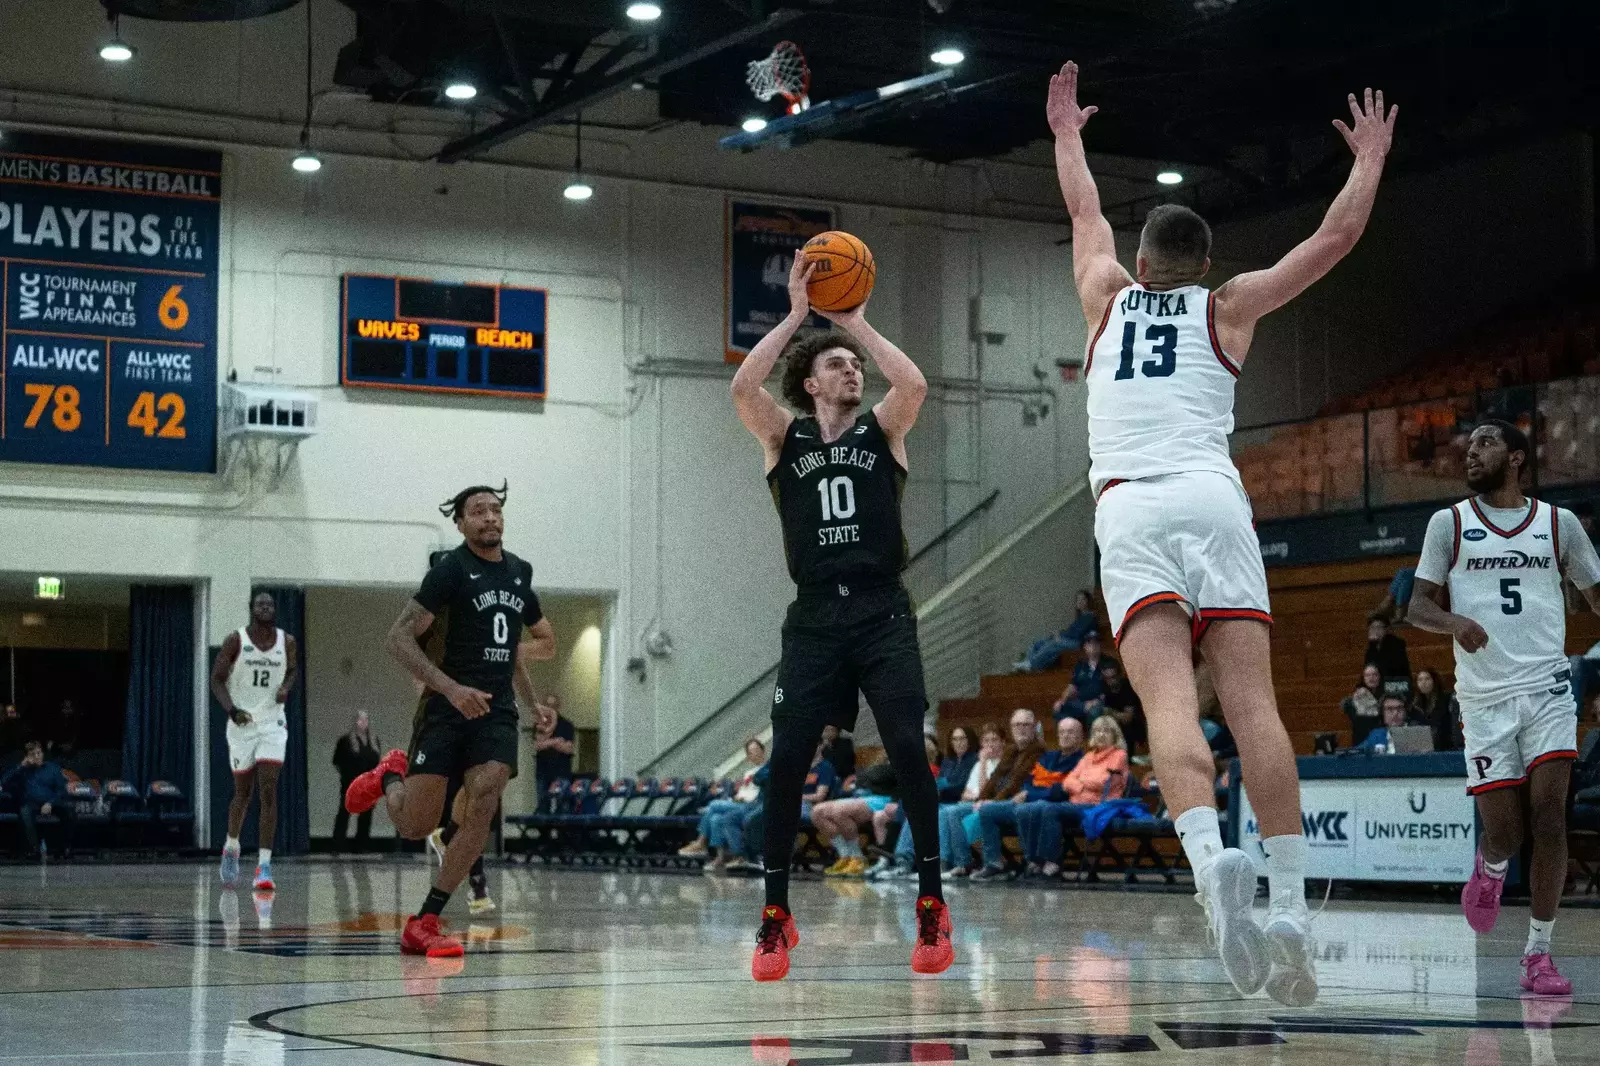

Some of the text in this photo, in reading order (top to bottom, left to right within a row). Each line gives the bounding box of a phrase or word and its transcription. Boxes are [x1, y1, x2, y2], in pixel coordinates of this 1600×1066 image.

[0, 157, 211, 195] MEN'S BASKETBALL
[174, 216, 193, 230] OF
[170, 230, 197, 246] THE
[164, 244, 203, 260] YEAR
[20, 272, 40, 319] WCC
[44, 275, 137, 296] TOURNAMENT
[46, 292, 134, 311] FINAL
[158, 285, 189, 330] 6
[43, 307, 136, 327] APPEARANCES
[358, 319, 420, 341] WAVES
[476, 328, 533, 350] BEACH
[12, 345, 99, 373] ALL-WCC
[126, 350, 191, 370] ALL-WCC
[1115, 321, 1178, 381] 13
[125, 367, 192, 383] FIRST TEAM
[24, 383, 81, 432] 78
[127, 392, 186, 439] 42
[791, 447, 877, 478] LONG BEACH
[817, 476, 856, 521] 10
[818, 524, 859, 546] STATE
[1466, 550, 1551, 571] PEPPERDINE
[472, 590, 525, 613] LONG BEACH
[1500, 578, 1522, 615] 5
[493, 612, 508, 644] 0
[483, 648, 511, 662] STATE
[253, 669, 270, 687] 12
[1469, 755, 1492, 780] P
[1365, 820, 1472, 839] UNIVERSITY
